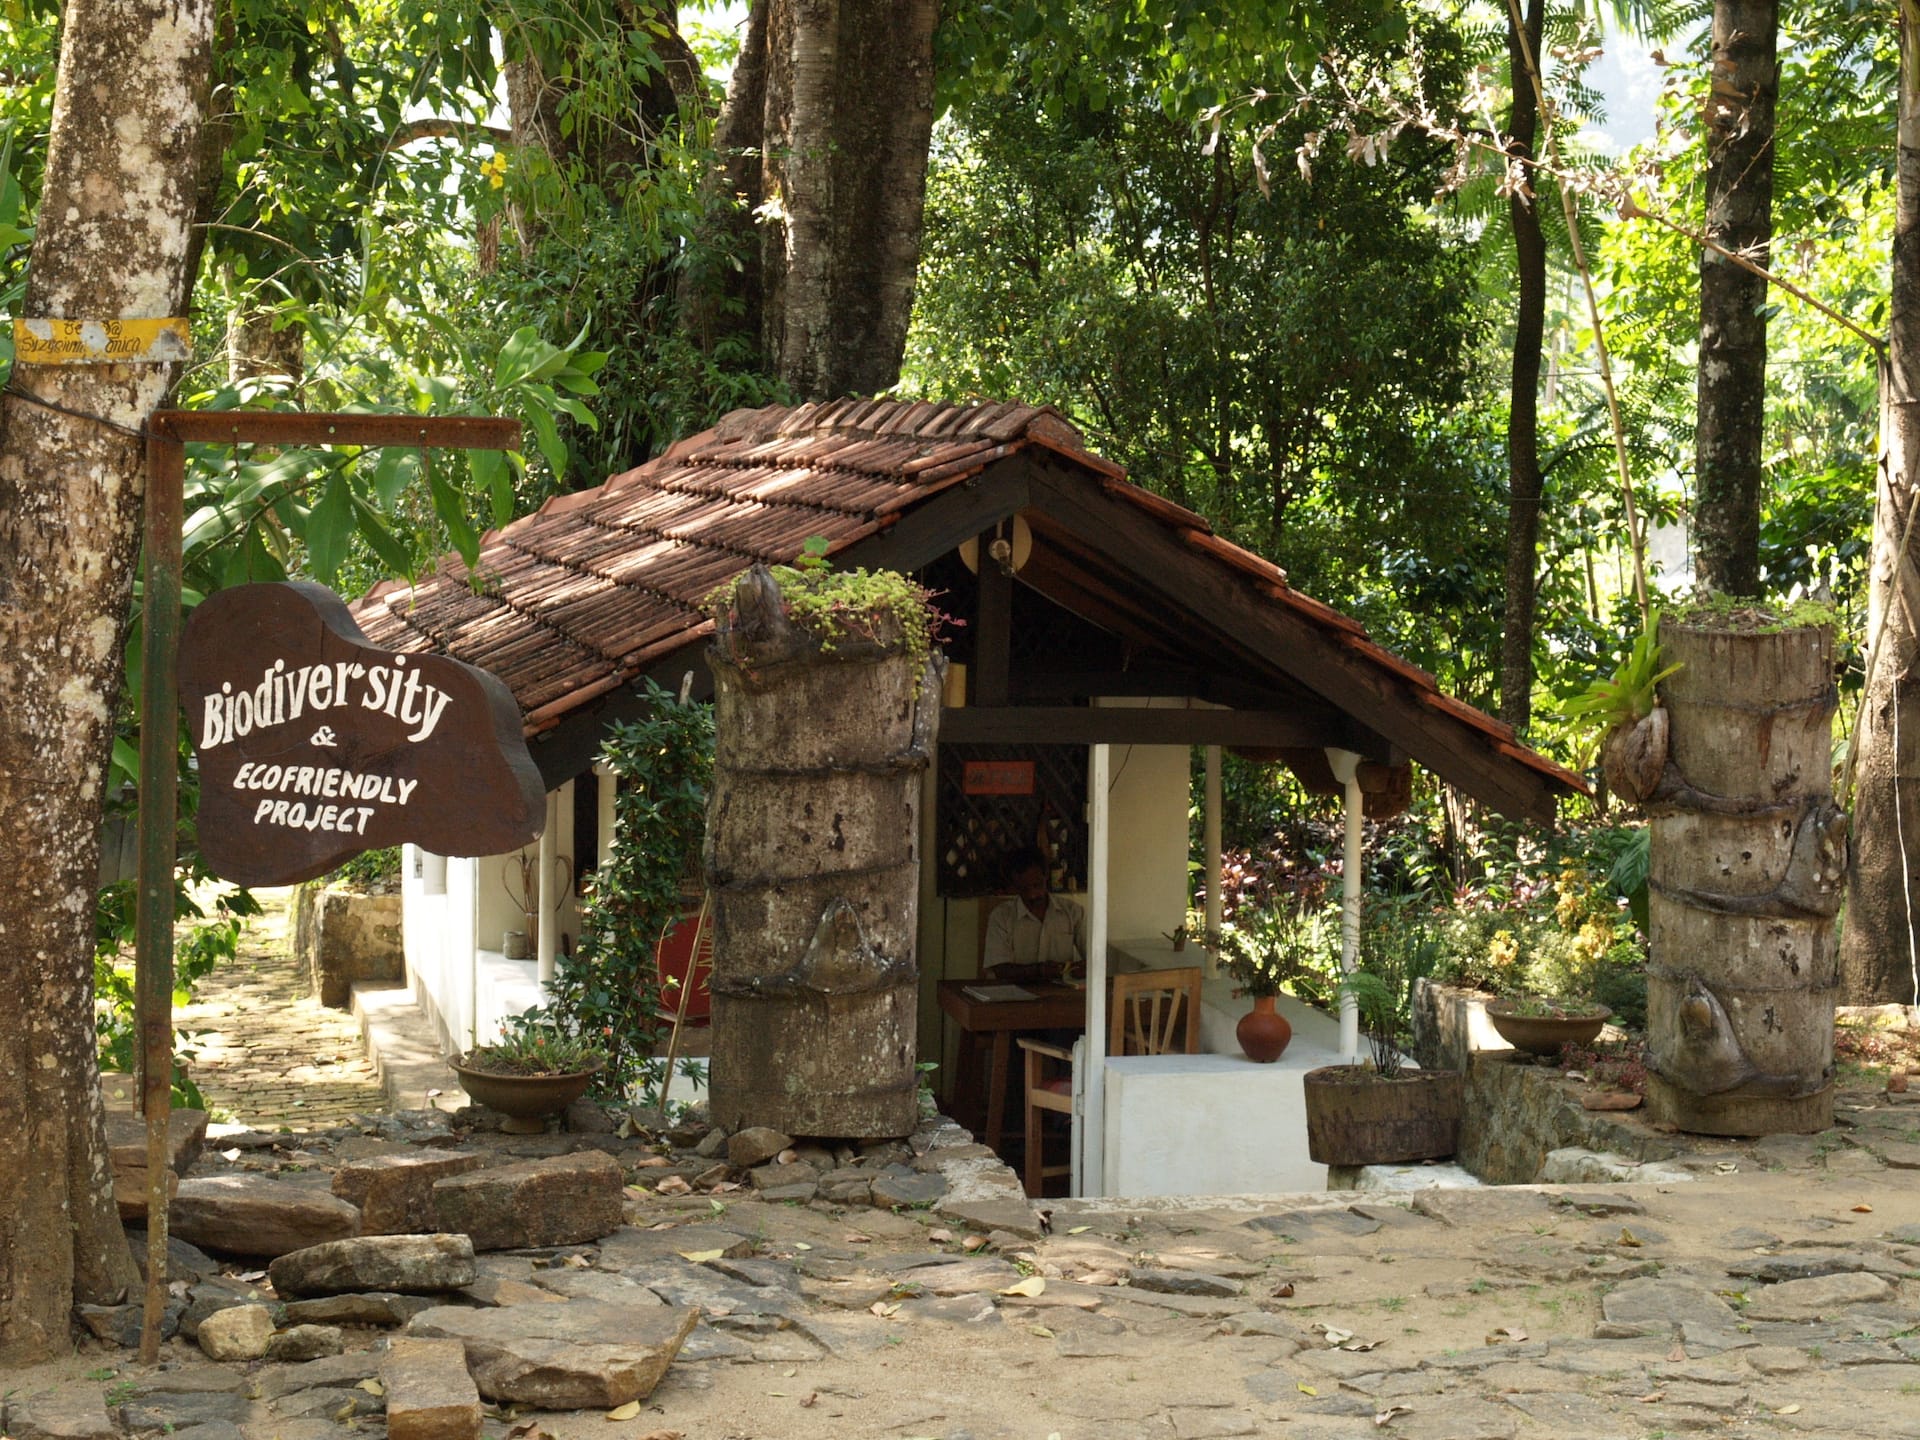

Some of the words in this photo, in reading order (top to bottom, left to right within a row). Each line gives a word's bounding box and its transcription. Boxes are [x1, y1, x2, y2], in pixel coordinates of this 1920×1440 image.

[200, 655, 453, 750] Biodiversity
[310, 725, 337, 747] &
[233, 762, 418, 805] ECOFRIENDLY
[254, 799, 375, 835] PROJECT
